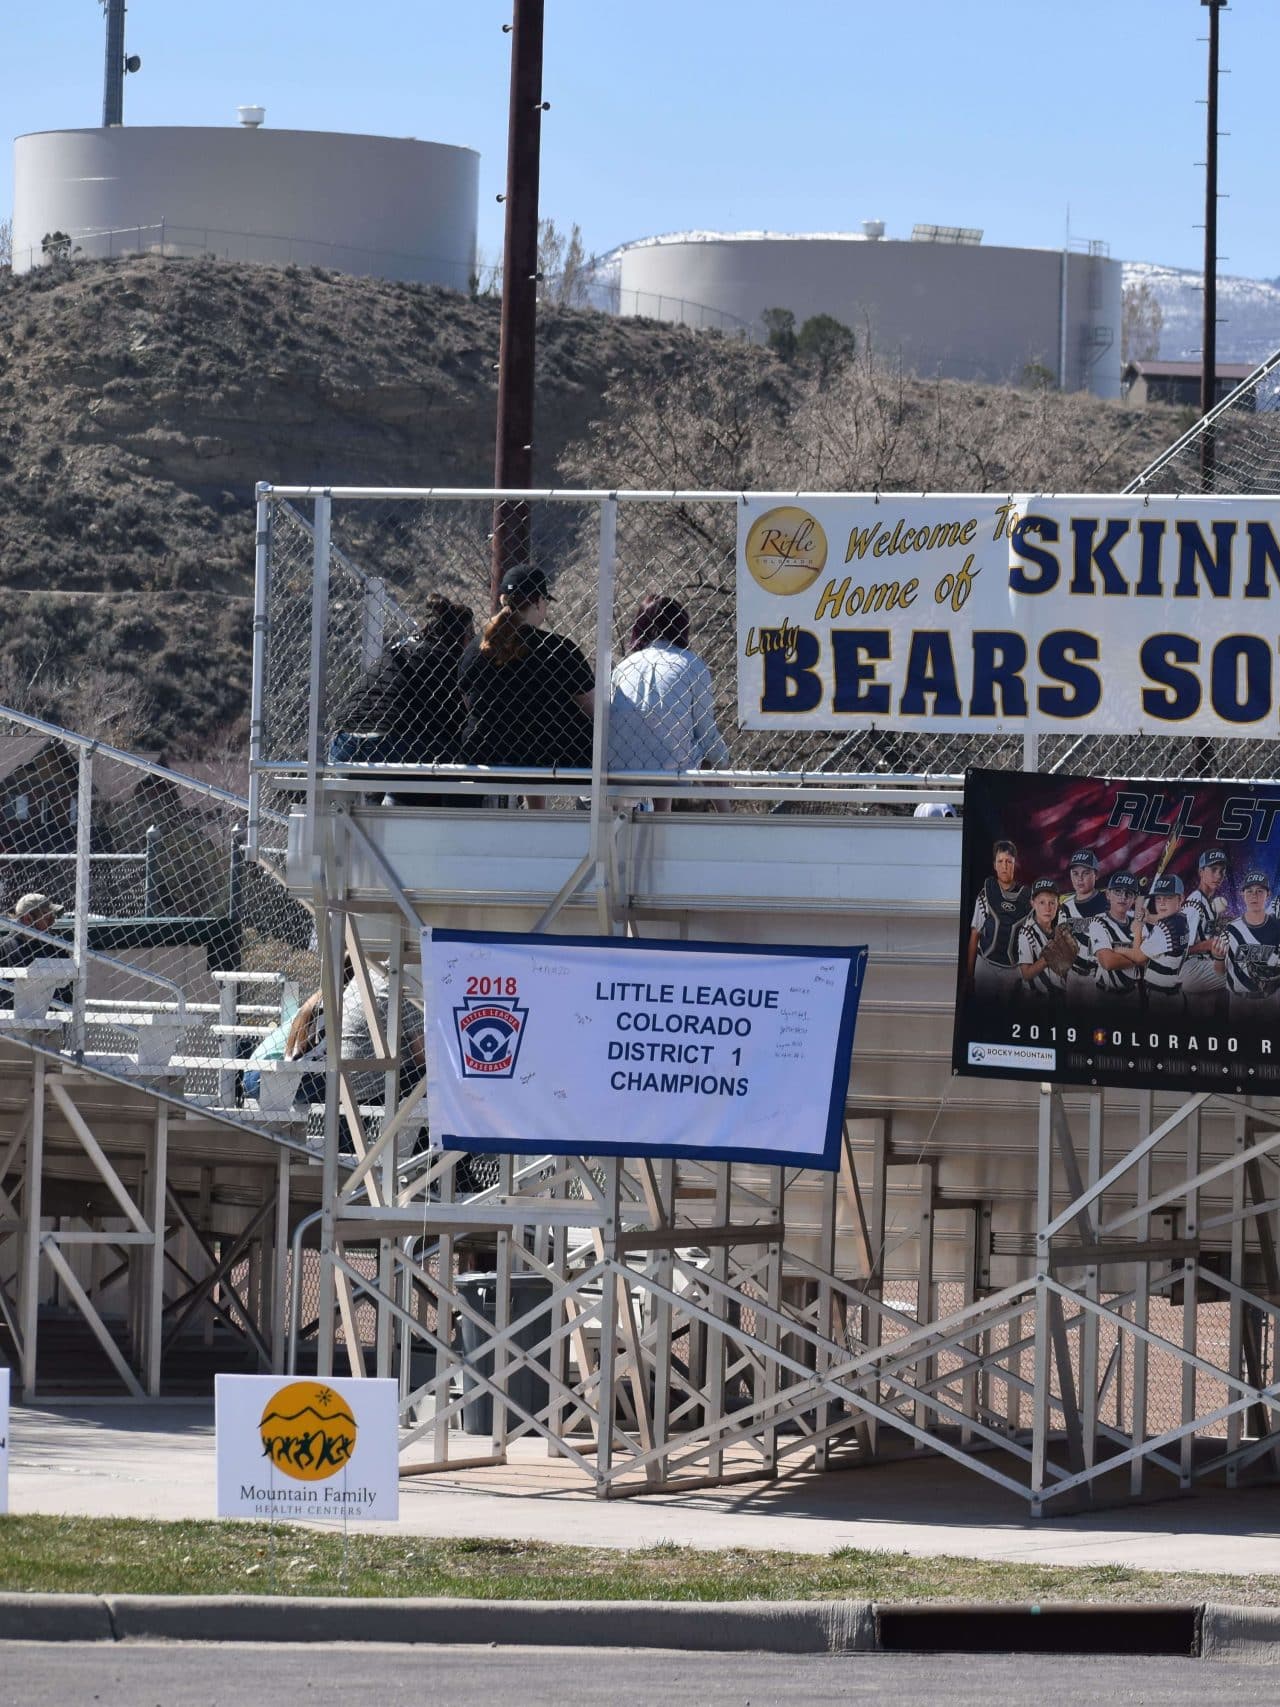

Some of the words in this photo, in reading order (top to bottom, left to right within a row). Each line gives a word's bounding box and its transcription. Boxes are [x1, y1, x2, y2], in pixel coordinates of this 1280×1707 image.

[760, 518, 816, 579] Rifle
[844, 518, 978, 564] Welcome
[814, 576, 920, 621] Home
[934, 553, 983, 612] of
[760, 628, 1101, 719] BEARS
[1107, 792, 1203, 838] ALL
[1035, 879, 1053, 889] CRV
[1115, 876, 1135, 885] CRV
[1247, 874, 1265, 882] CRV
[466, 976, 517, 995] 2018
[596, 982, 674, 1003] LITTLE
[682, 986, 779, 1009] LEAGUE
[461, 1009, 489, 1026] LITTLE
[490, 1009, 519, 1027] LEAGUE
[616, 1012, 751, 1037] COLORADO
[1012, 1024, 1077, 1042] 2019
[607, 1041, 715, 1065] DISTRICT
[732, 1048, 741, 1066] 1
[988, 1048, 1012, 1056] ROCKY
[1014, 1051, 1053, 1059] MOUNTAIN
[469, 1059, 508, 1071] BASEBALL
[610, 1071, 749, 1096] CHAMPIONS
[240, 1485, 317, 1501] Mountain
[324, 1487, 377, 1507] Family
[255, 1504, 302, 1514] HEALTH
[307, 1505, 362, 1516] CENTERS
